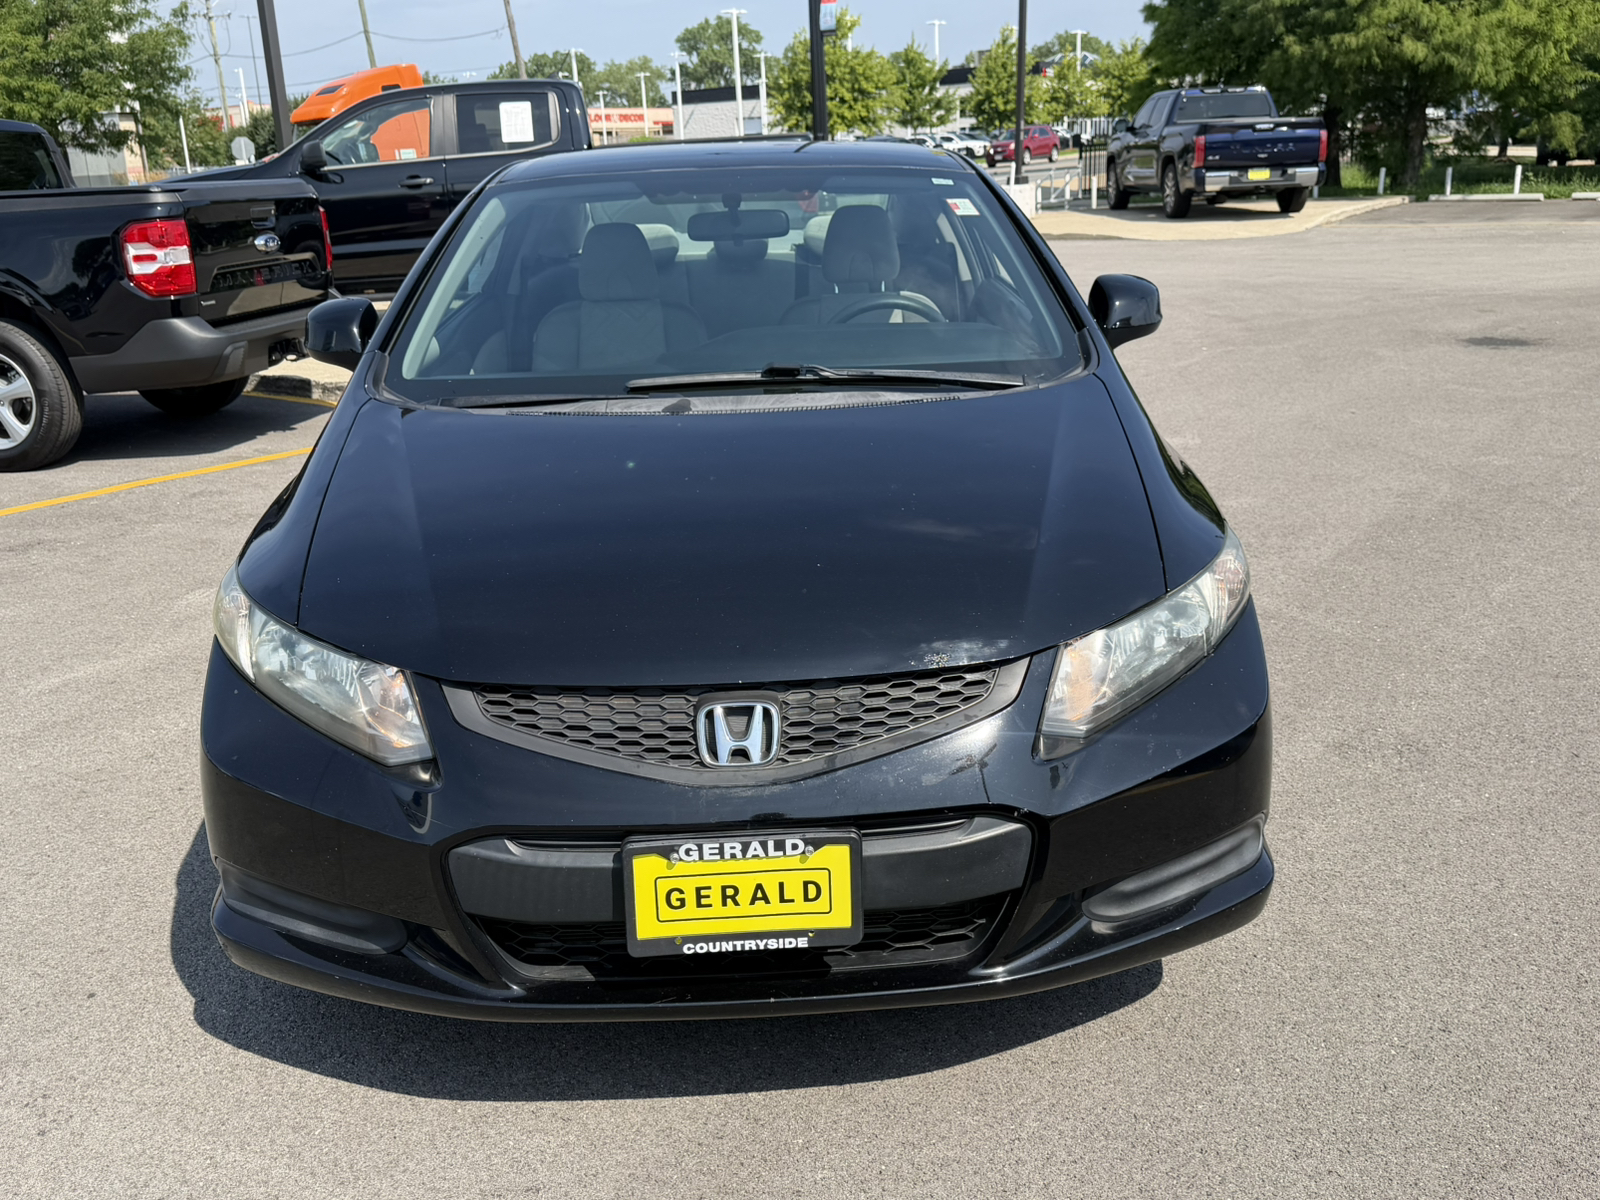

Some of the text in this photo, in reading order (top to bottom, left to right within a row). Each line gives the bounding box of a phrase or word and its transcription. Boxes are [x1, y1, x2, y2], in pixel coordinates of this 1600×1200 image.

[216, 261, 312, 288] MAVERICK
[678, 838, 805, 862] GERALD
[664, 880, 823, 911] GERALD
[682, 936, 809, 955] COUNTRYSIDE
